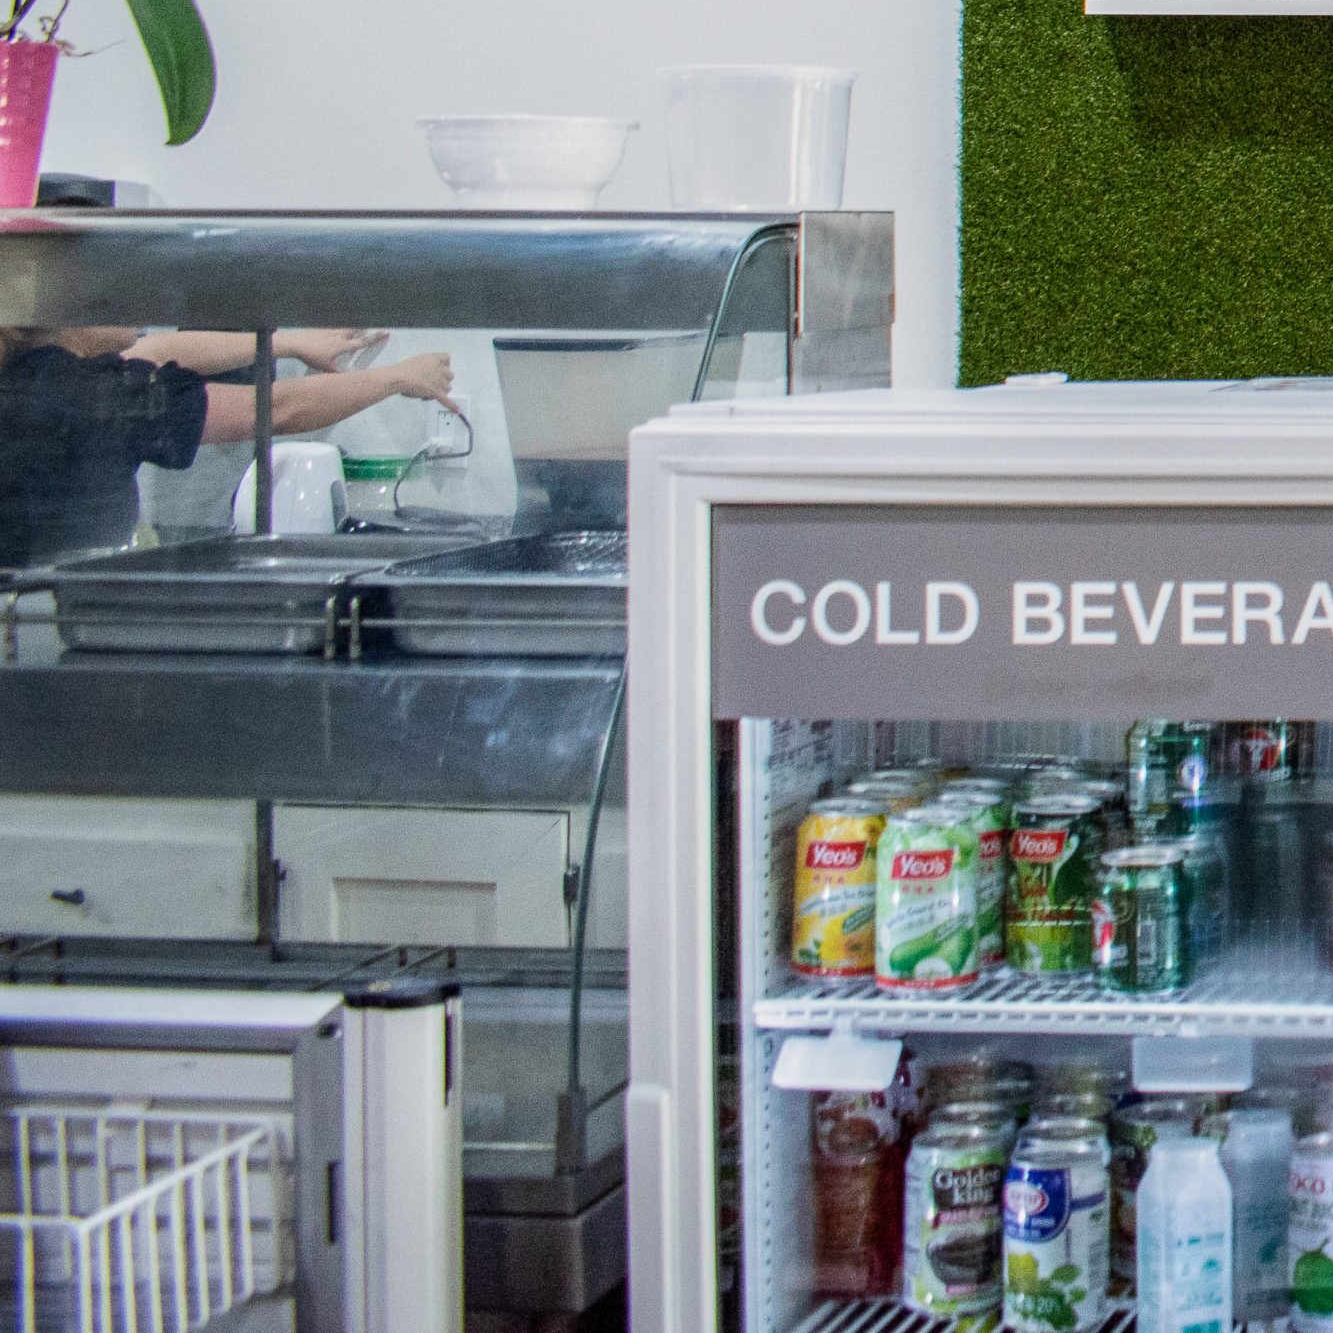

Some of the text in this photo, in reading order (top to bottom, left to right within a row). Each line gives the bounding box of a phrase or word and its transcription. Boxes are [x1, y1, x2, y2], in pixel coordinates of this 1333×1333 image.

[749, 579, 981, 647] COLD
[812, 845, 858, 866] Yeo's
[901, 854, 947, 876] Yeo's
